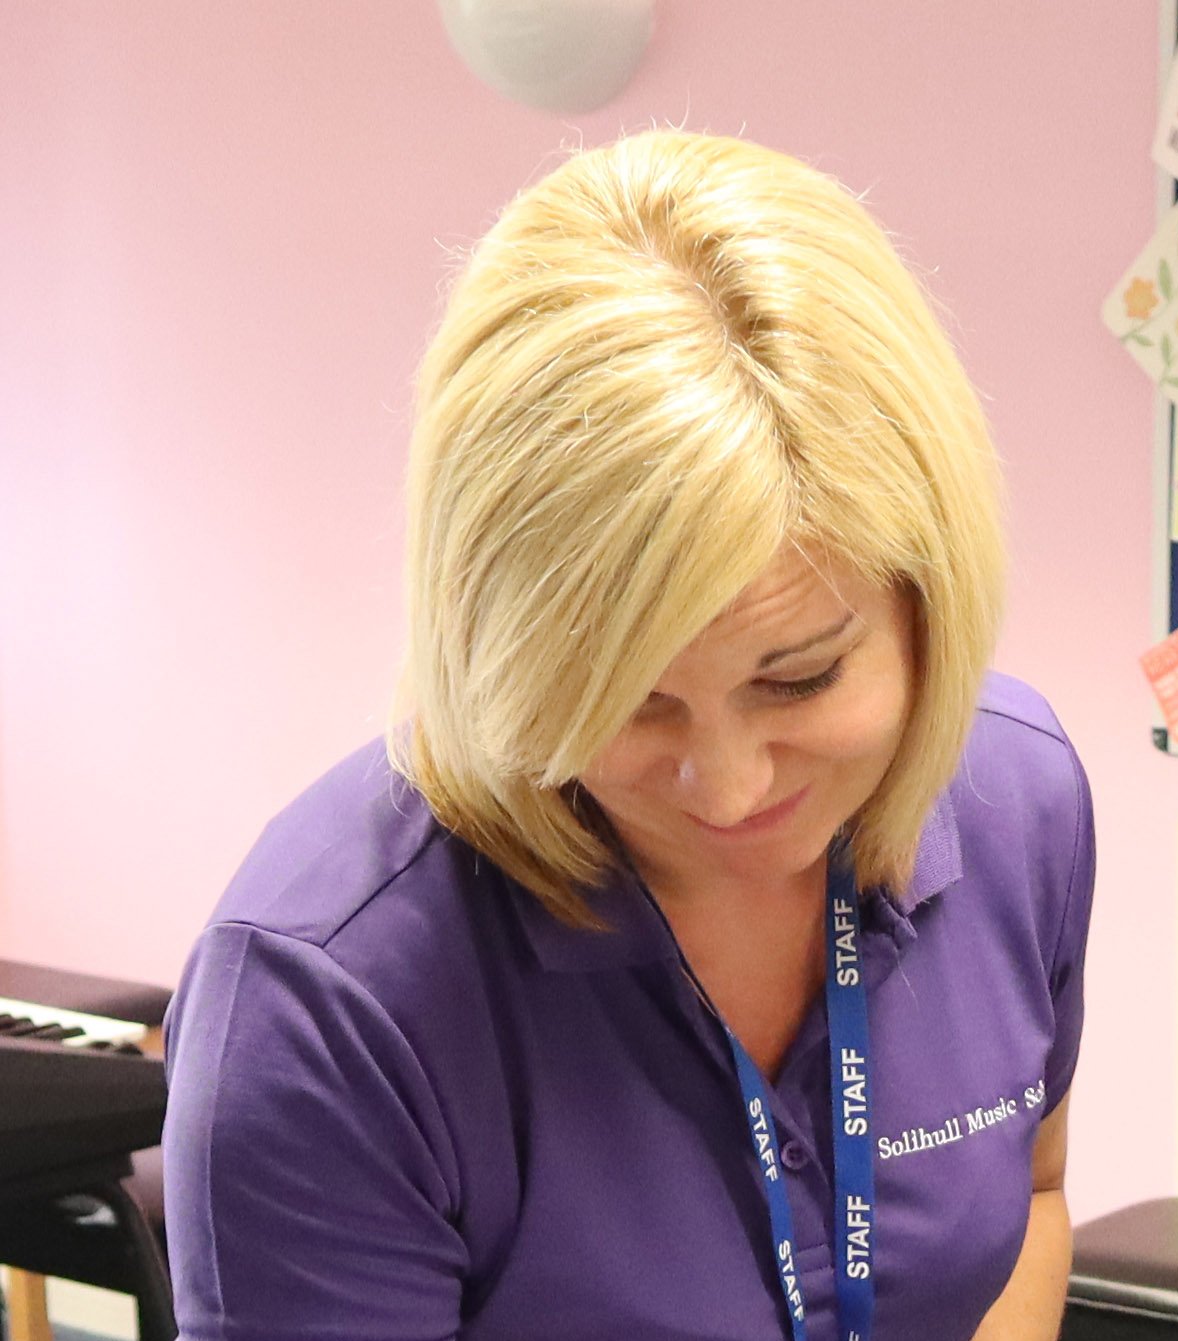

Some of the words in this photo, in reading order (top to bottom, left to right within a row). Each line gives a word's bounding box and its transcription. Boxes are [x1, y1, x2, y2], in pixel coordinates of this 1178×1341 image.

[834, 898, 861, 987] STAFF
[841, 1047, 866, 1136] STAFF
[877, 1117, 964, 1160] Solihull
[965, 1097, 1018, 1135] Music
[749, 1096, 780, 1183] STAFF
[778, 1239, 806, 1322] STAFF
[846, 1195, 872, 1280] STAFF
